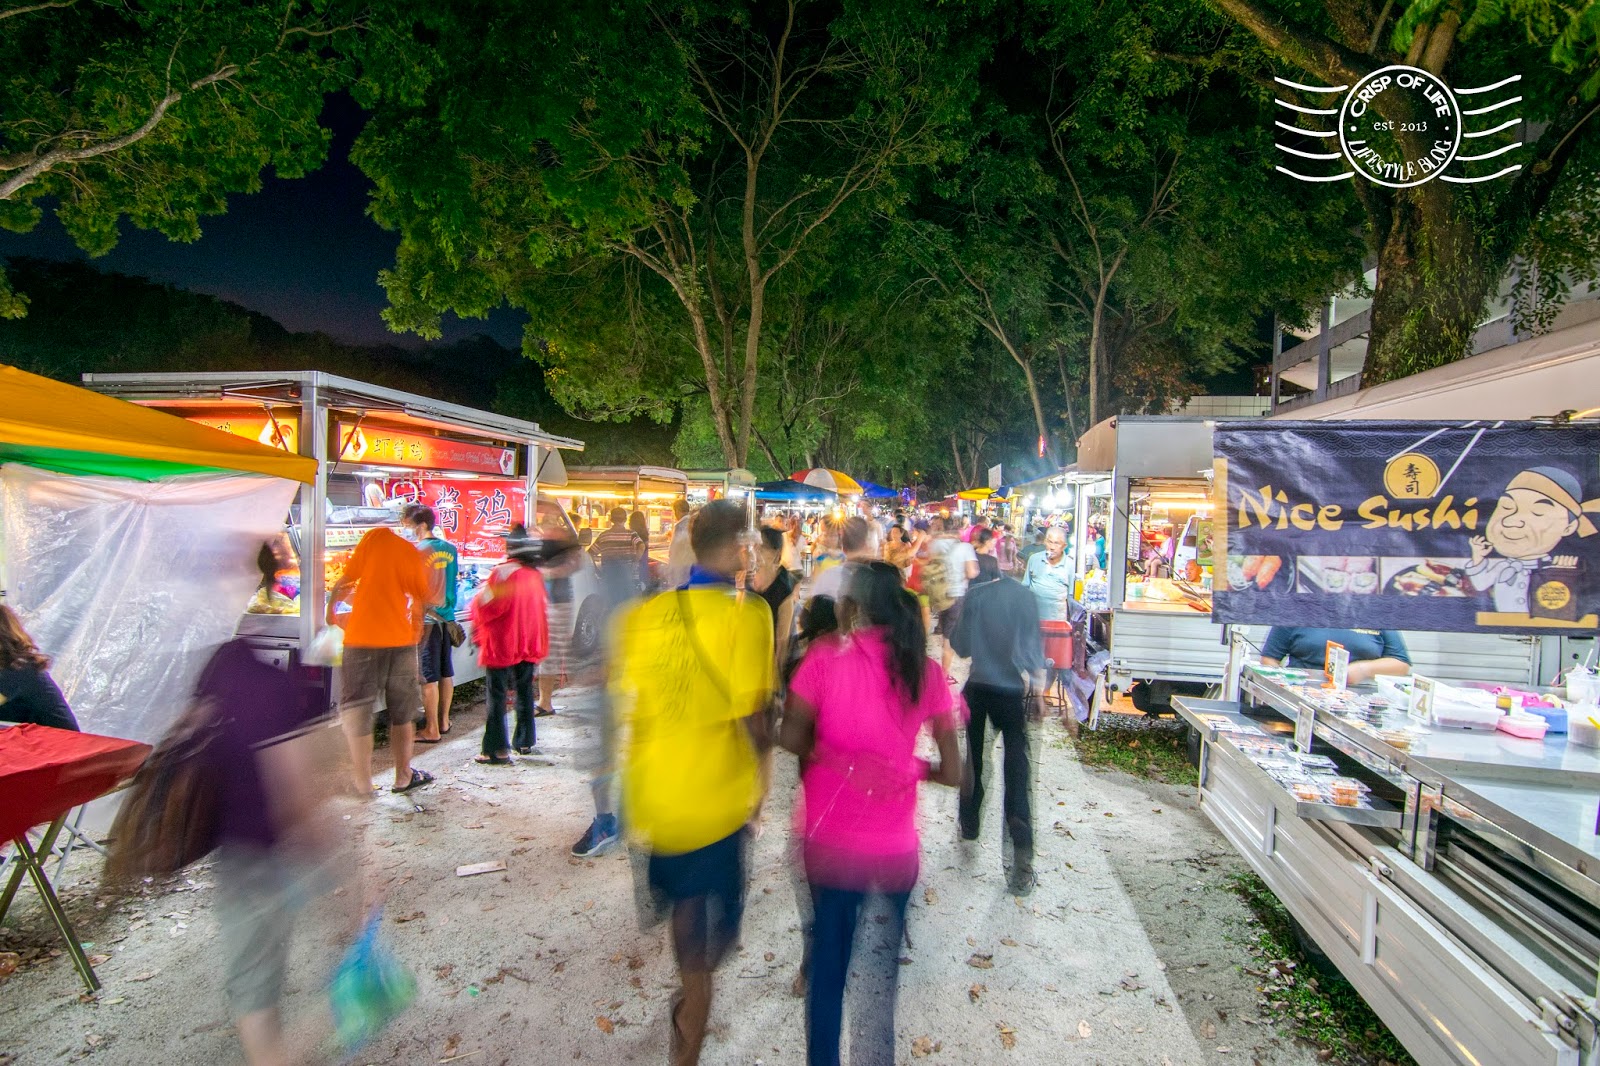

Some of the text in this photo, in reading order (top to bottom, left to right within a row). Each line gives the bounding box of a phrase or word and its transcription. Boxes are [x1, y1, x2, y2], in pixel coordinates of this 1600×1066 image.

[1238, 484, 1479, 532] Nice Sushi
[1416, 694, 1427, 716] 4
